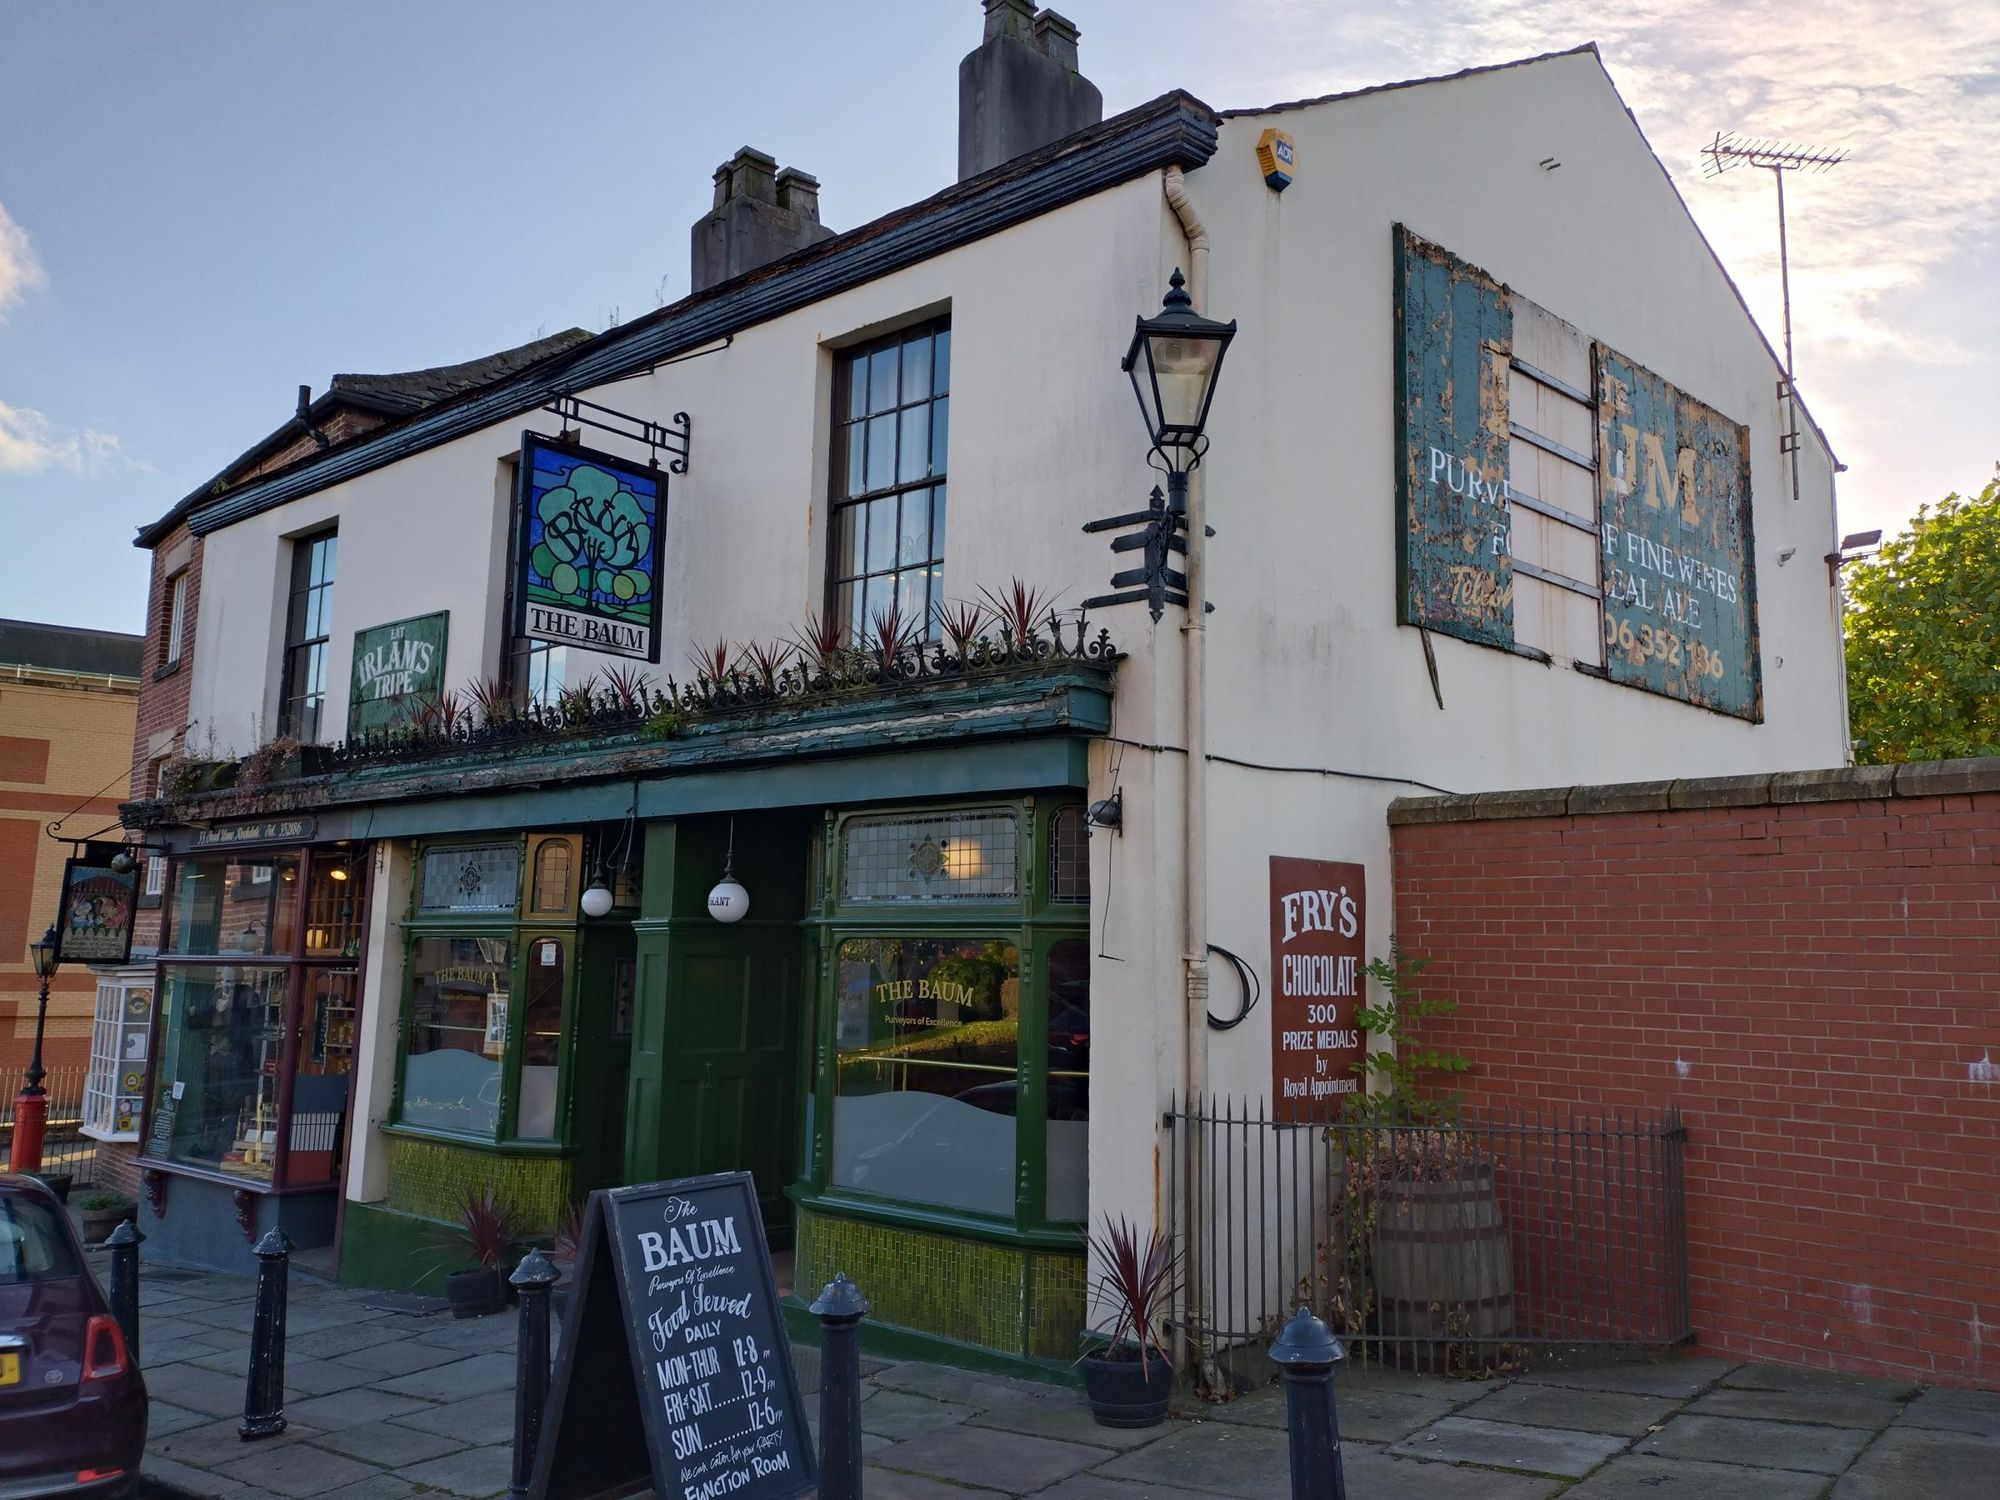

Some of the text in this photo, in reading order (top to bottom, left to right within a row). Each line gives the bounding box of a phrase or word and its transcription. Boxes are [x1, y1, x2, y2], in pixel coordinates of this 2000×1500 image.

[1602, 522, 1618, 555] F
[1627, 532, 1674, 578] FINE
[1678, 556, 1737, 604] WINES
[1606, 568, 1654, 611] EAL
[1663, 589, 1701, 629] ALE
[391, 626, 405, 640] EAT
[531, 608, 645, 650] THE BAUM
[374, 670, 413, 699] TRIPE
[1281, 886, 1357, 943] FRY'S
[434, 967, 488, 986] THE BAUM
[1282, 954, 1358, 996] CHOCOLATE
[876, 980, 975, 1007] THE BAUM
[885, 1015, 962, 1028] Purveyors of Excellence
[1307, 1004, 1337, 1024] 300
[1282, 1029, 1358, 1051] PRIZE MEDALS
[1315, 1054, 1328, 1076] by
[1283, 1075, 1358, 1101] Royal Appointment
[664, 1196, 698, 1223] The
[637, 1216, 742, 1273] BAUM
[648, 1283, 752, 1352] Food Served
[684, 1319, 721, 1344] DAILY
[656, 1346, 721, 1391] MON-THUR
[664, 1391, 686, 1425] FRI
[756, 1429, 783, 1453] PARTY
